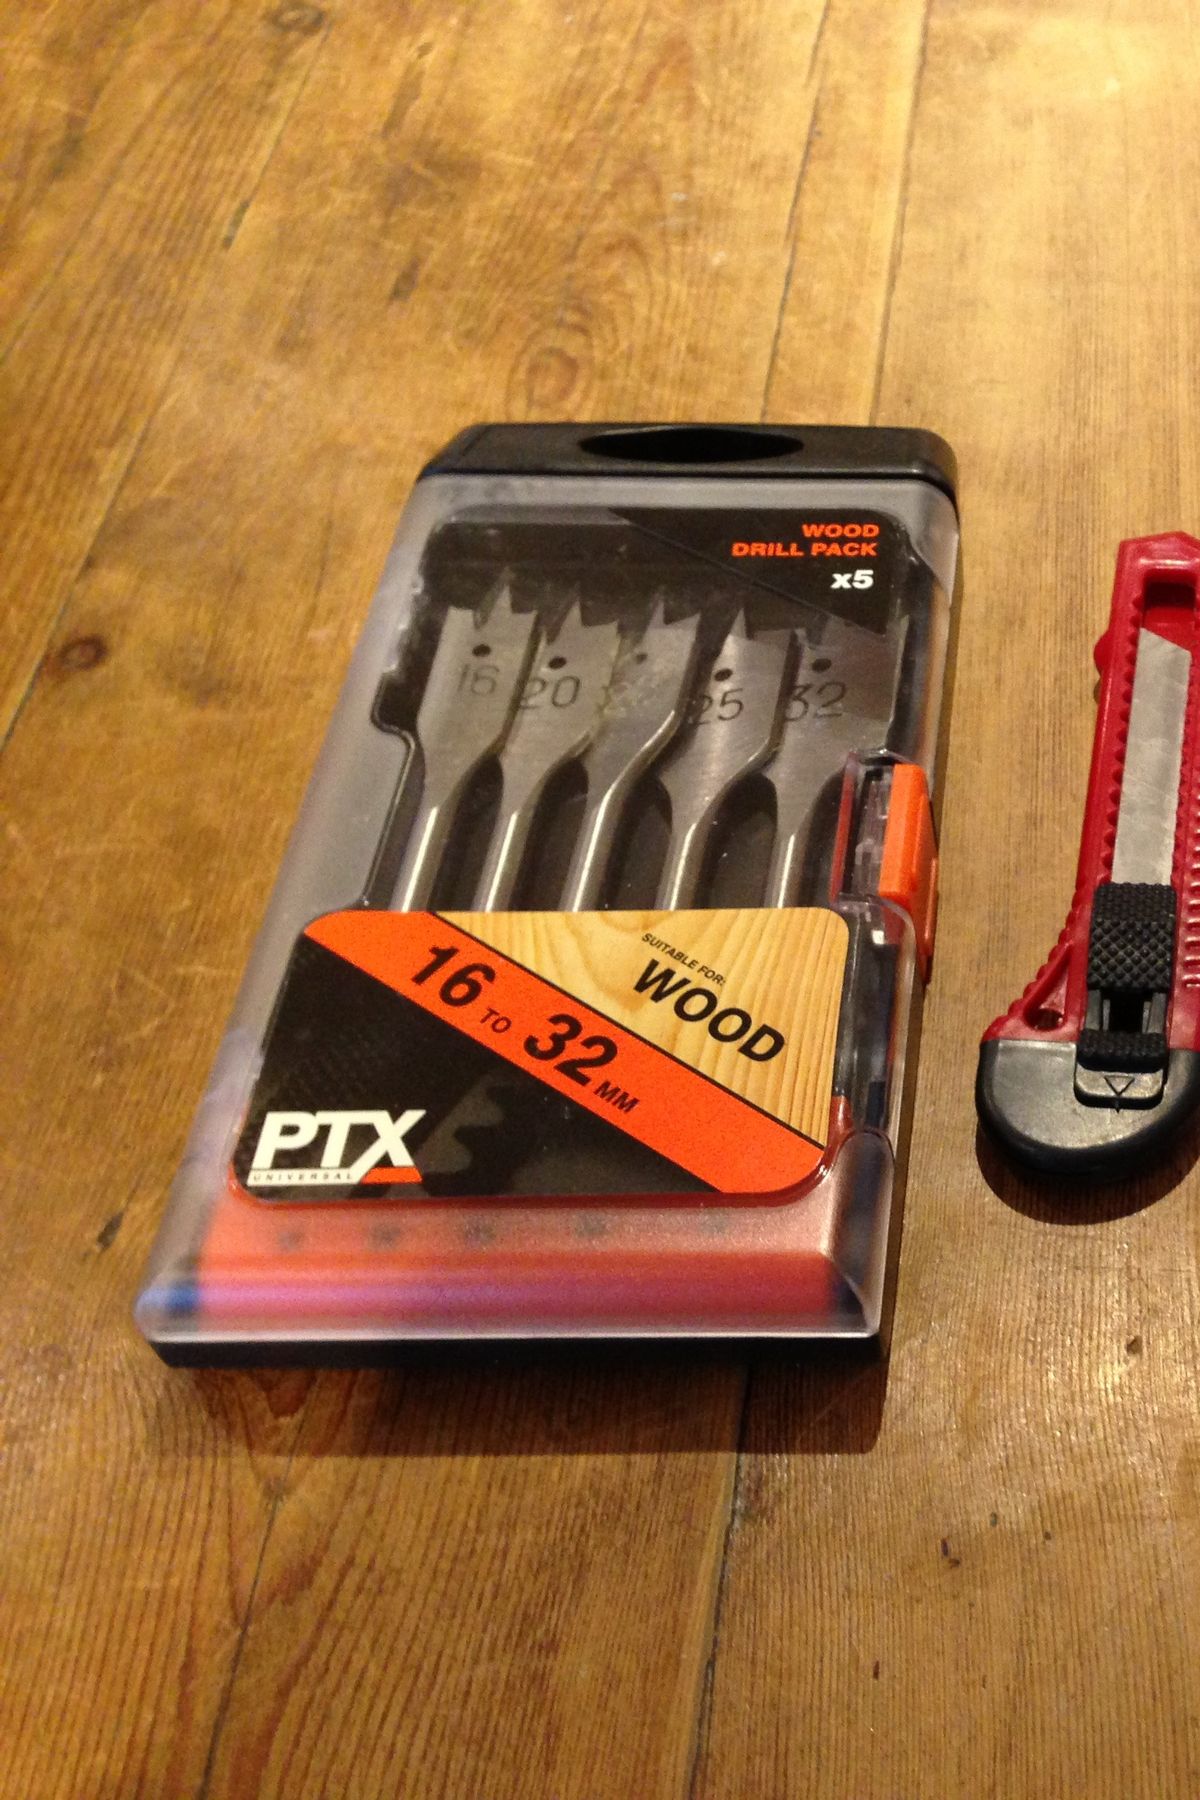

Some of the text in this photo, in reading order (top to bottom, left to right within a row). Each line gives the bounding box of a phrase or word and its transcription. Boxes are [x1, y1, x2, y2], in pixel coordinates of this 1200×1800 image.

[802, 523, 880, 538] WOOD
[731, 542, 877, 557] DRILL PACK
[830, 569, 874, 589] x5
[457, 664, 500, 696] 16
[641, 932, 726, 986] SUITABLE FOR:
[633, 958, 785, 1062] WOOD
[411, 945, 640, 1114] 16 TO 32 MM
[251, 1109, 427, 1169] PTX
[252, 1172, 354, 1182] UNIVERSAL
